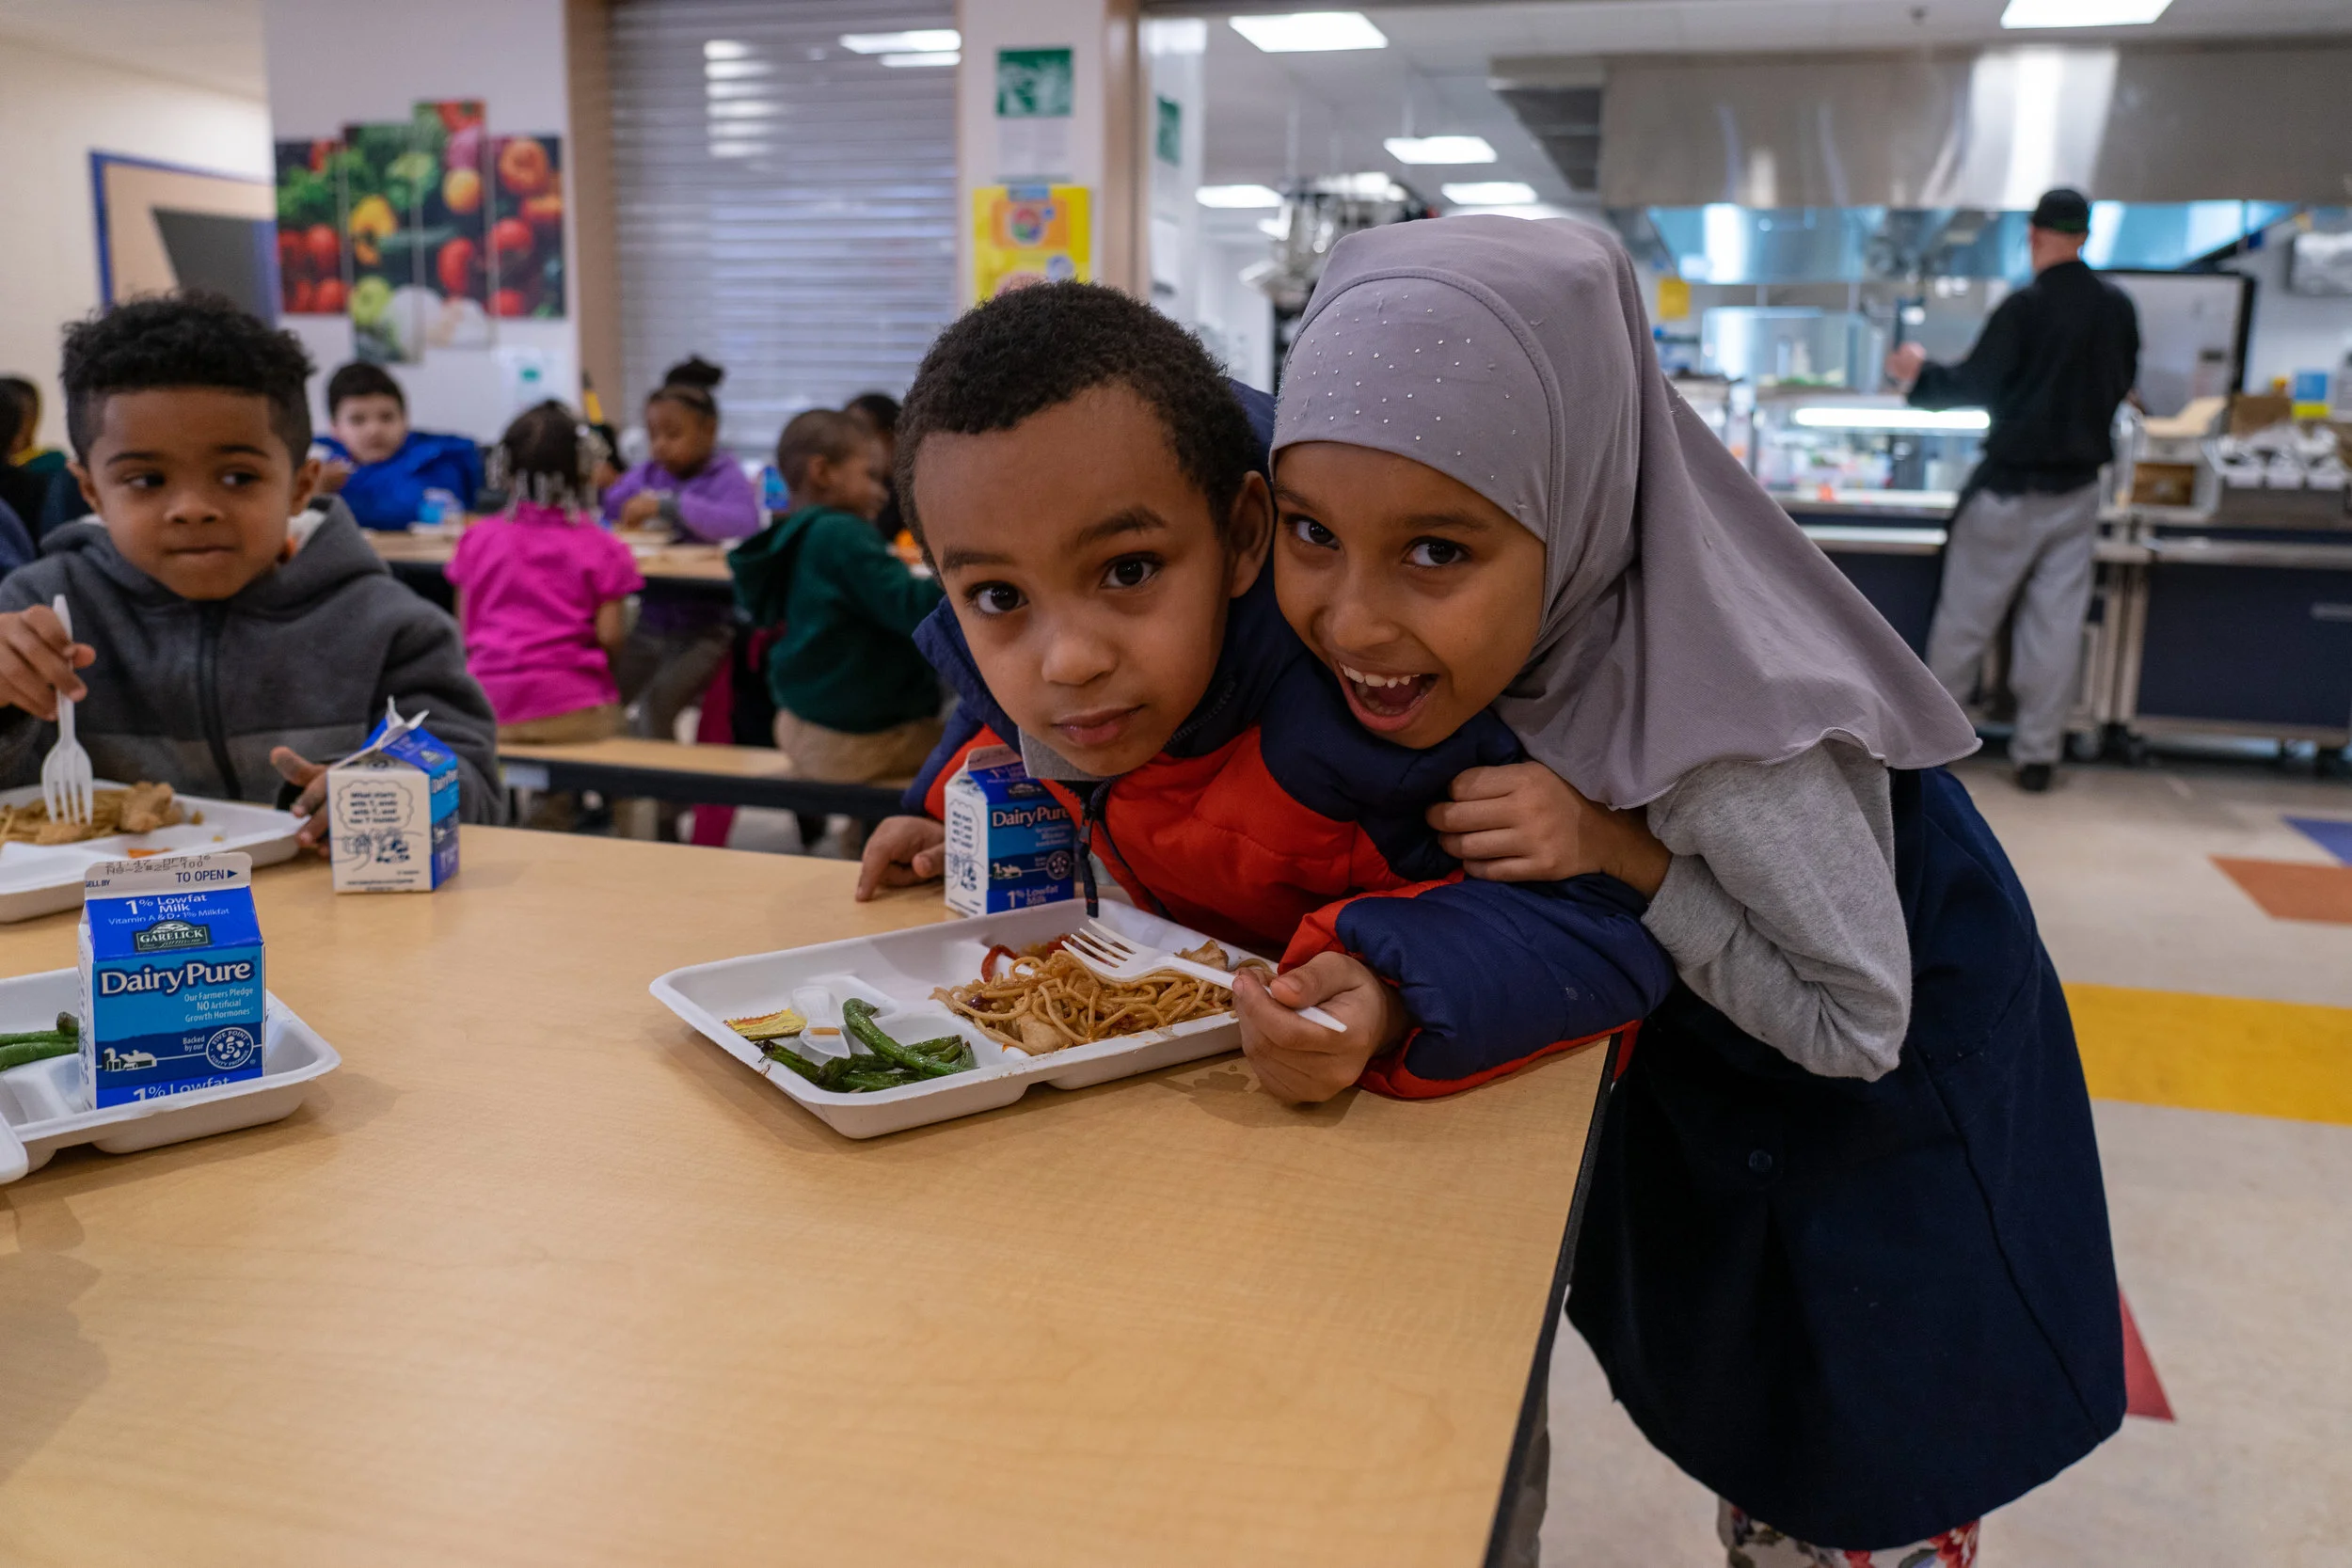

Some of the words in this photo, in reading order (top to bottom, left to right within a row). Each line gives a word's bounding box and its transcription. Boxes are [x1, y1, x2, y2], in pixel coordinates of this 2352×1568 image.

[175, 871, 191, 883] TO
[194, 869, 225, 882] OPEN
[157, 894, 207, 906] Lowfat
[159, 903, 191, 913] Milk
[108, 916, 147, 926] Vitamin
[199, 908, 230, 917] Milkfat
[139, 928, 204, 943] GARELICK
[101, 961, 251, 995] DairyPure
[184, 993, 198, 1002] Our
[199, 990, 229, 1000] Farmers
[229, 987, 253, 997] Pledge
[197, 1002, 210, 1011] NO
[211, 999, 241, 1009] Artificial
[185, 1012, 213, 1022] Growth
[183, 1036, 205, 1045] Backed
[212, 1031, 227, 1045] FIVE
[228, 1030, 248, 1041] POINT
[226, 1042, 236, 1054] 5
